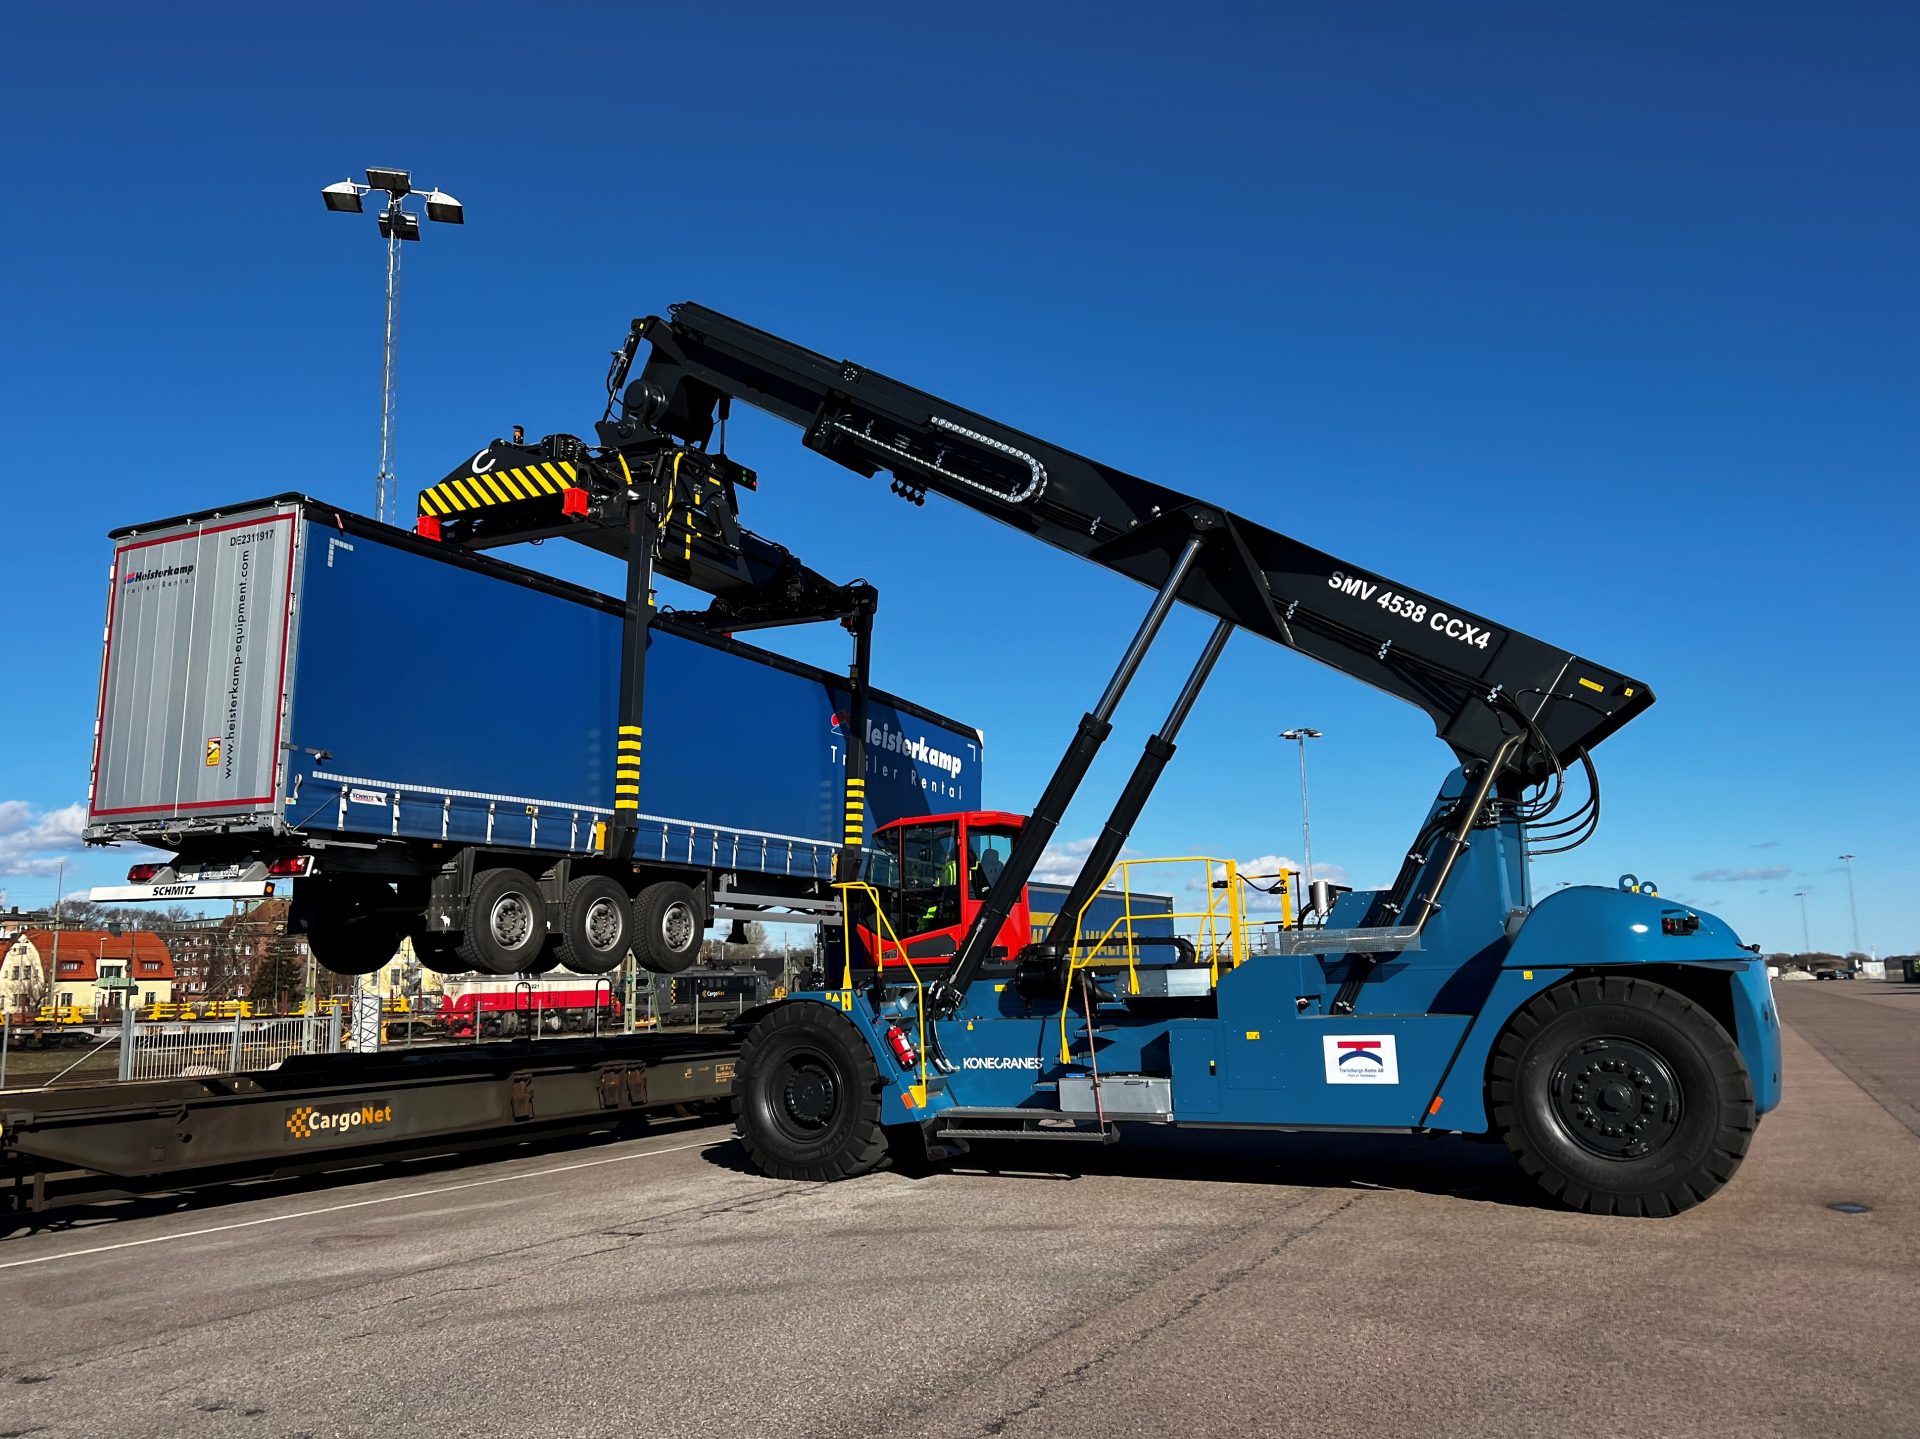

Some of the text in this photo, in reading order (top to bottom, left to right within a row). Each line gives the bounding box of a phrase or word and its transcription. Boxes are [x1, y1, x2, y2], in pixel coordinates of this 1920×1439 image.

[230, 529, 275, 547] DE2311917
[135, 564, 194, 583] Heisterkamp
[1328, 570, 1491, 650] SMV 4538 CCX4
[224, 550, 250, 780] www.heisterkamp-equipment.com
[830, 745, 962, 800] Triler Rental
[152, 885, 196, 896] SCHMITZ
[963, 1057, 1043, 1070] KONECRANES
[308, 1106, 392, 1132] CargoNet
